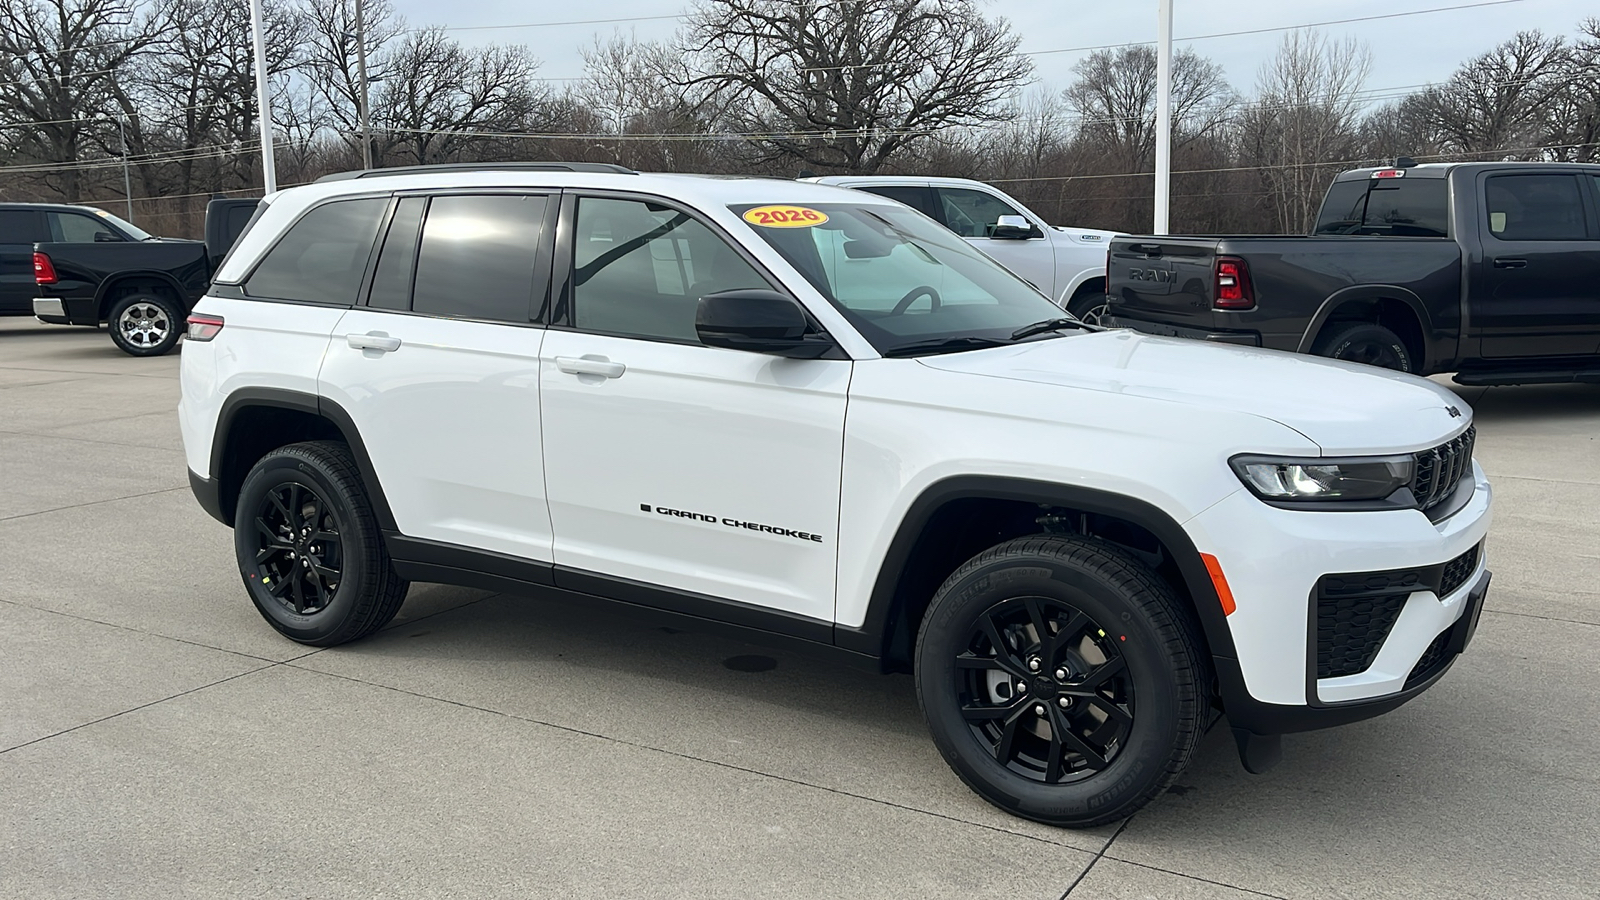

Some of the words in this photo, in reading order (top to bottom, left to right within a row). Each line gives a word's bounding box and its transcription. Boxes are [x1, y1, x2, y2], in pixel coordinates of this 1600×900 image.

[754, 210, 820, 223] 2026
[1128, 267, 1178, 284] RAM
[656, 506, 717, 523] GRAND
[722, 518, 823, 543] CHEROKEE
